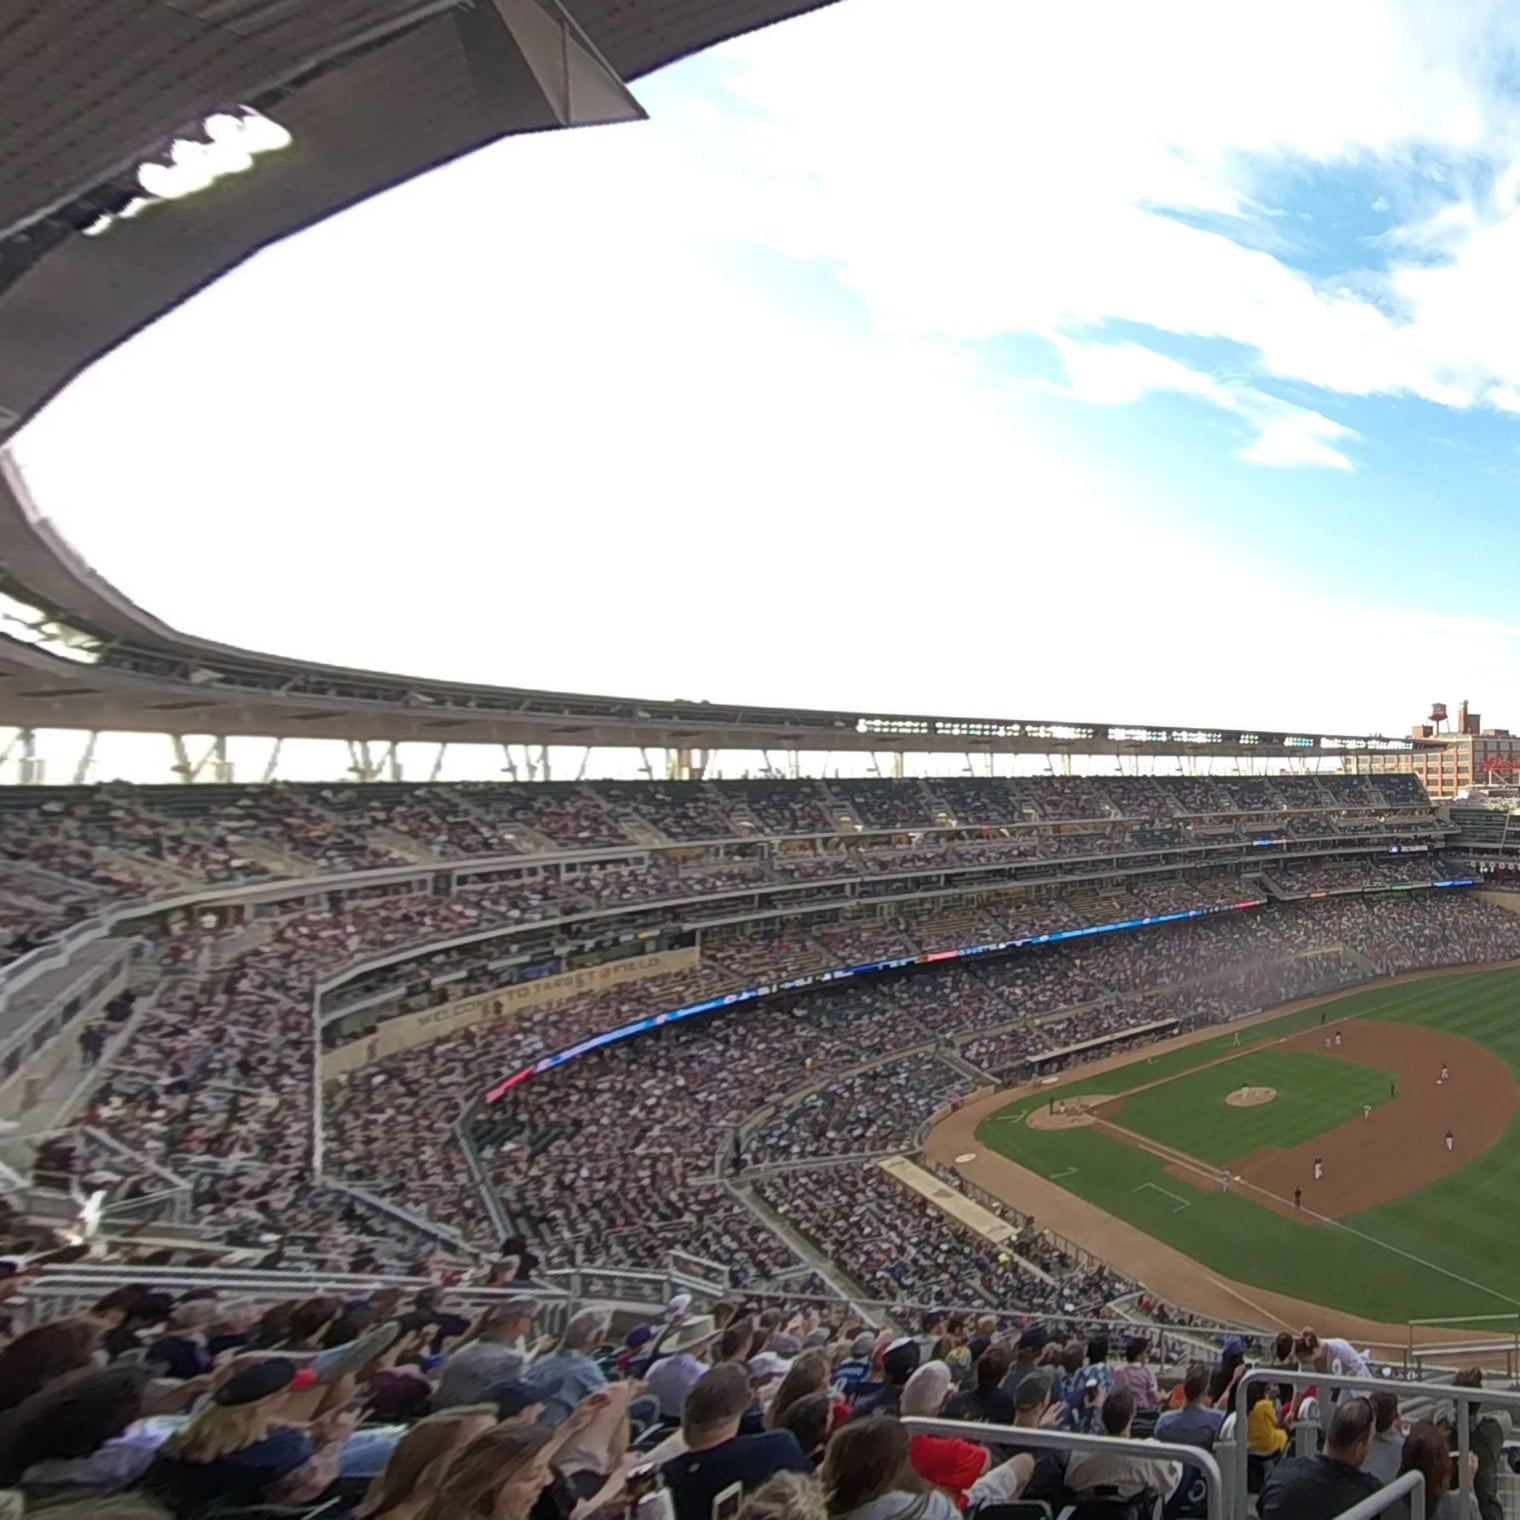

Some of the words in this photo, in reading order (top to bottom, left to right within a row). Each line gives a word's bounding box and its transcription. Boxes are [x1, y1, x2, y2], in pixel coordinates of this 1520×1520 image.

[507, 985, 529, 1001] TO
[535, 969, 596, 994] TARGET
[613, 957, 660, 974] FIELD
